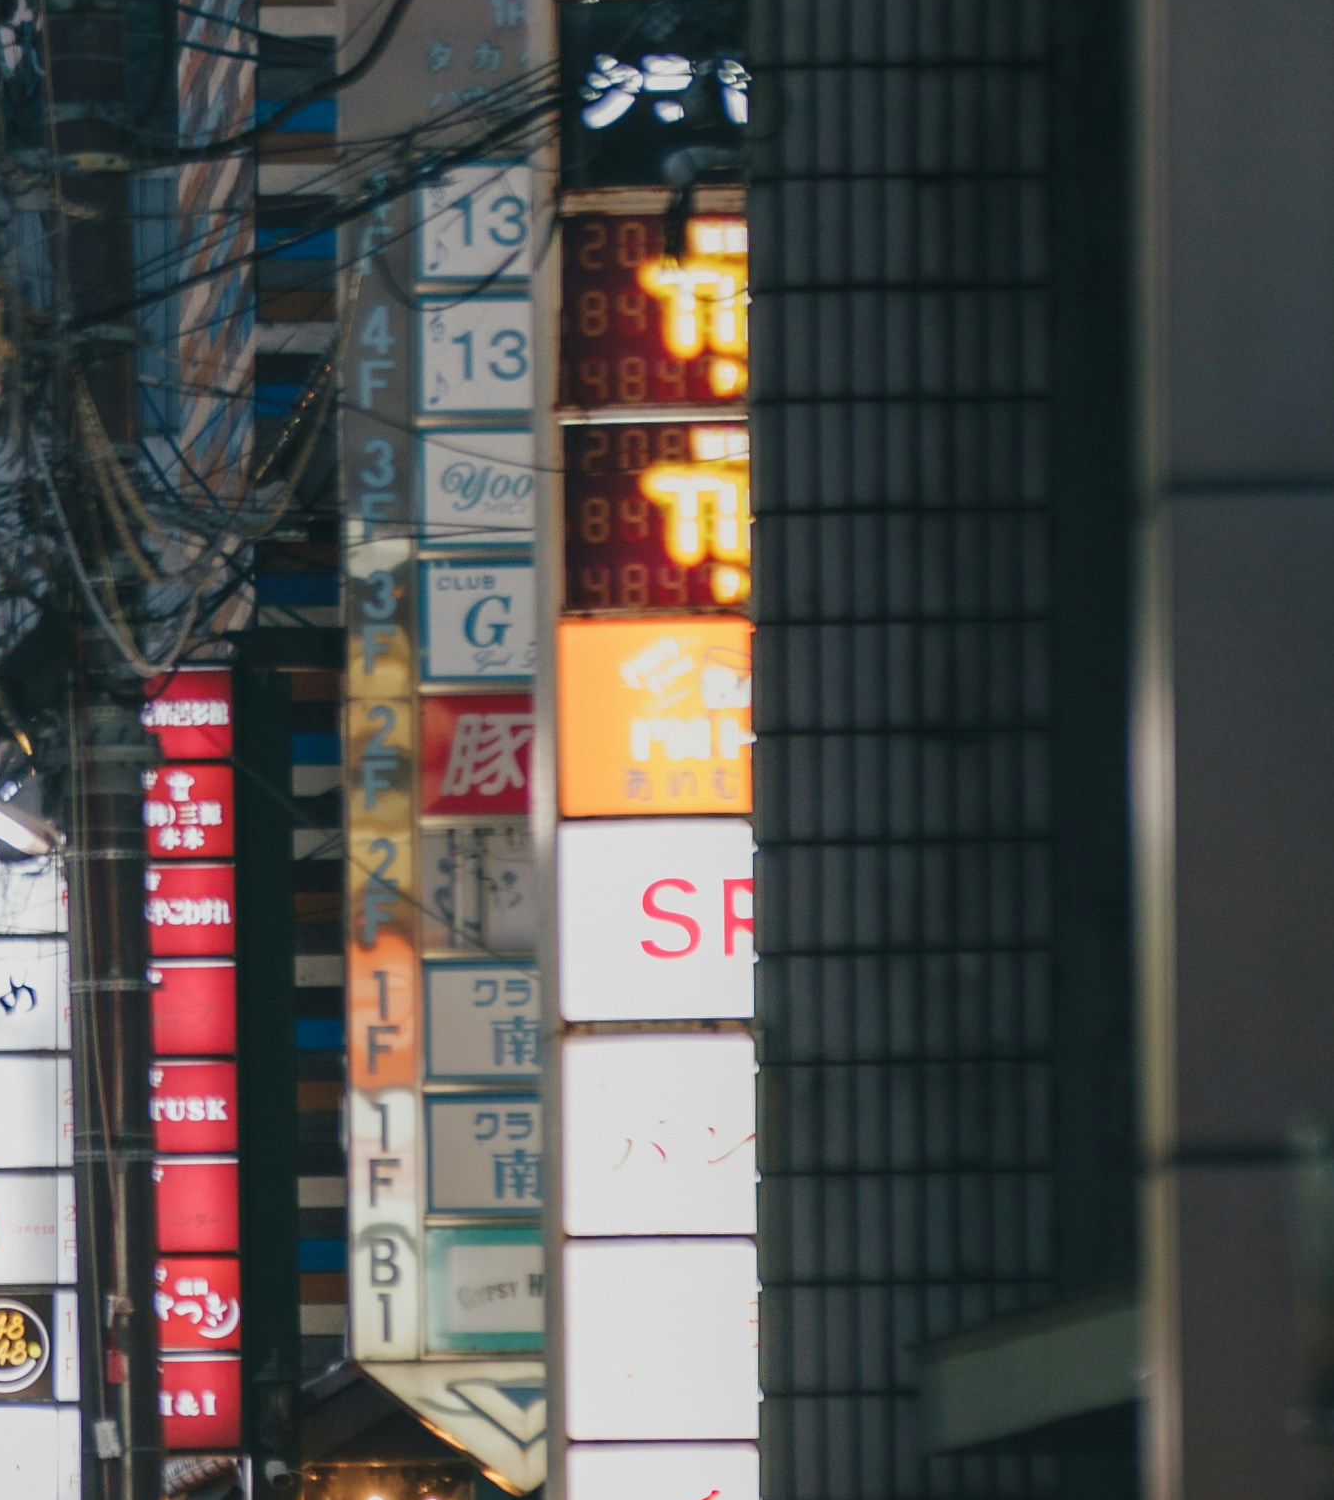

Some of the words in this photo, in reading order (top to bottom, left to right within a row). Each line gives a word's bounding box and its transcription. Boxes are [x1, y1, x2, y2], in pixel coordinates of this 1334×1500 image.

[426, 40, 528, 73] タカ
[452, 195, 528, 248] 13
[357, 306, 395, 409] 4F
[452, 330, 528, 381] 13
[363, 572, 398, 676] 3F
[437, 575, 497, 590] CLUB
[463, 595, 514, 649] G
[363, 707, 398, 811] 2F
[363, 839, 399, 945] 2F
[367, 970, 398, 1075] 1F
[367, 1104, 401, 1208] 1F
[368, 1237, 401, 1343] B1
